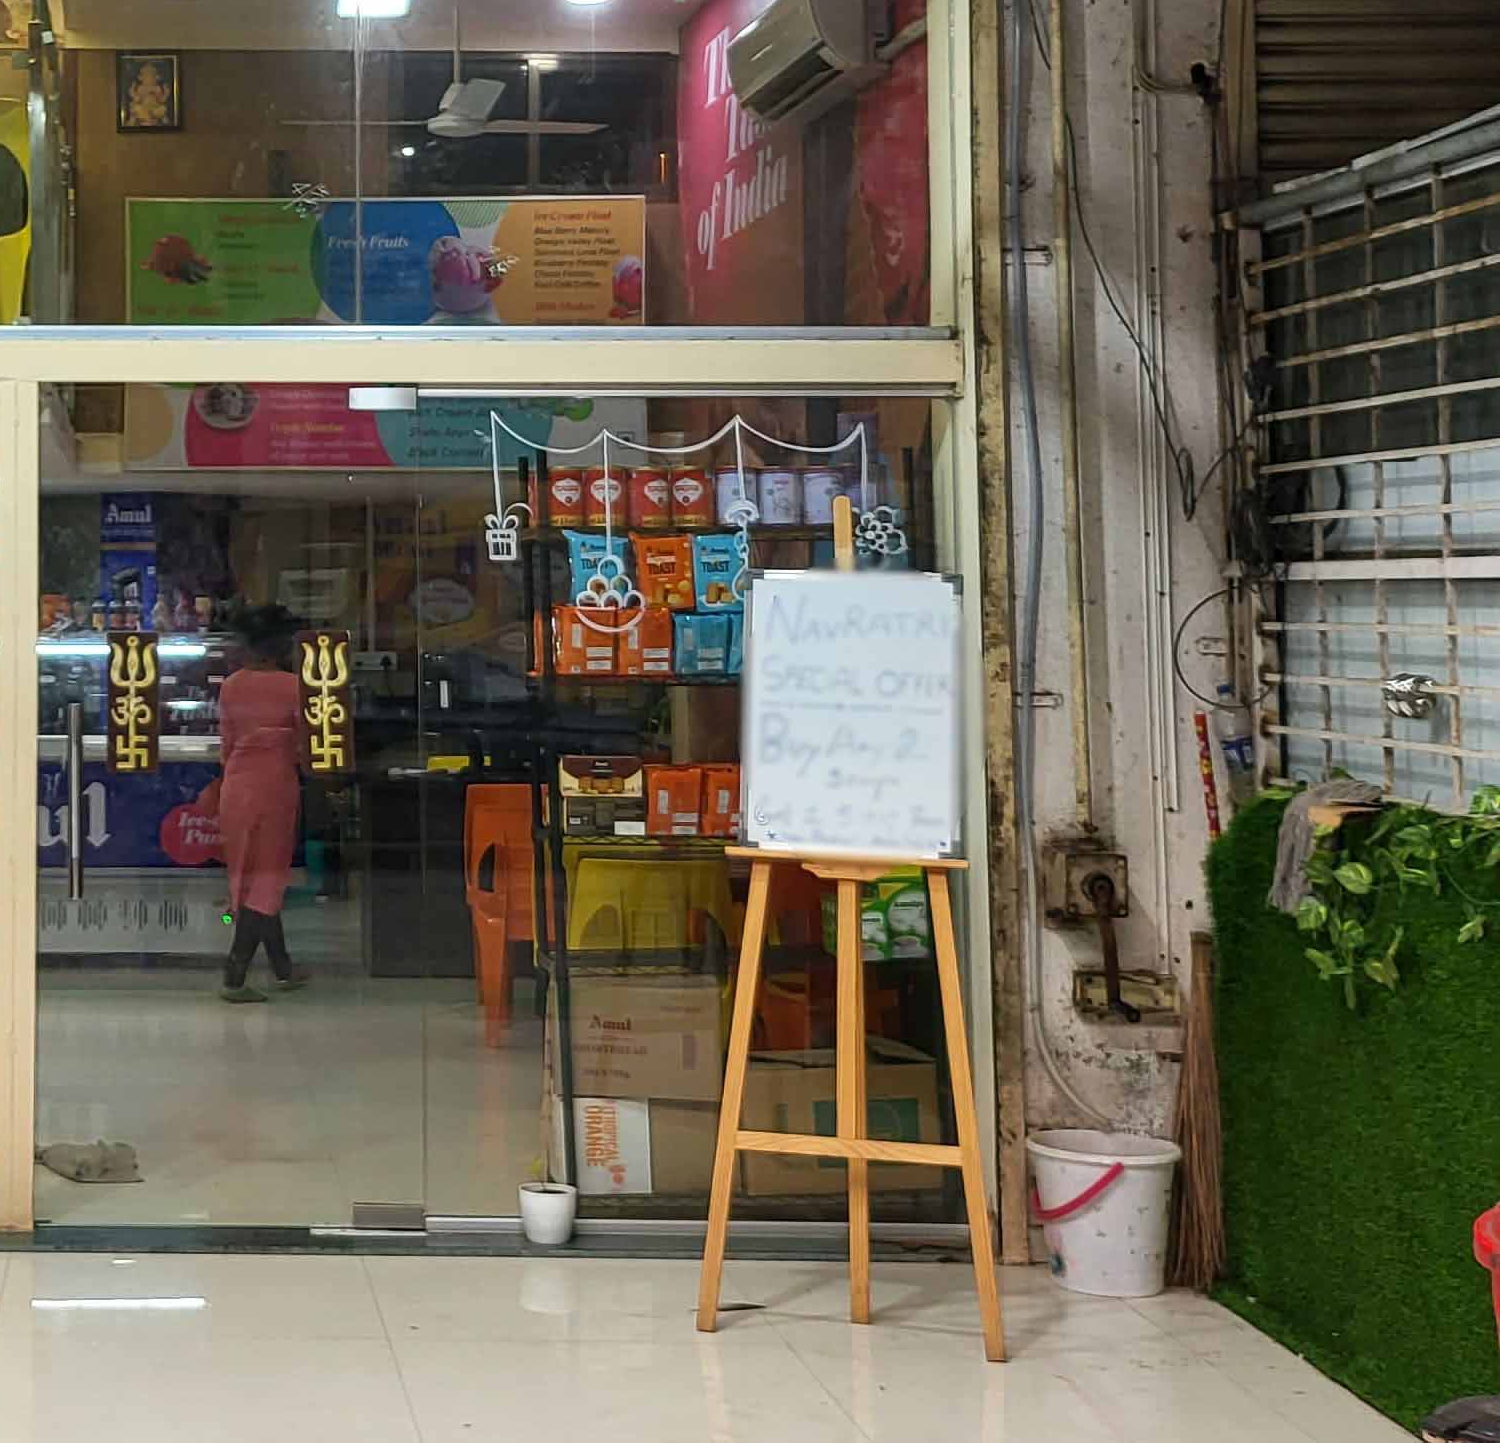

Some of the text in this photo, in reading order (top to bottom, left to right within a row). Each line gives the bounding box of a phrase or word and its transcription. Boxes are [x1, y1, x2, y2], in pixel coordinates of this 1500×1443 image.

[698, 145, 789, 271] of India
[105, 503, 152, 523] Amul
[702, 560, 731, 573] TOAST
[589, 1014, 632, 1032] Amul
